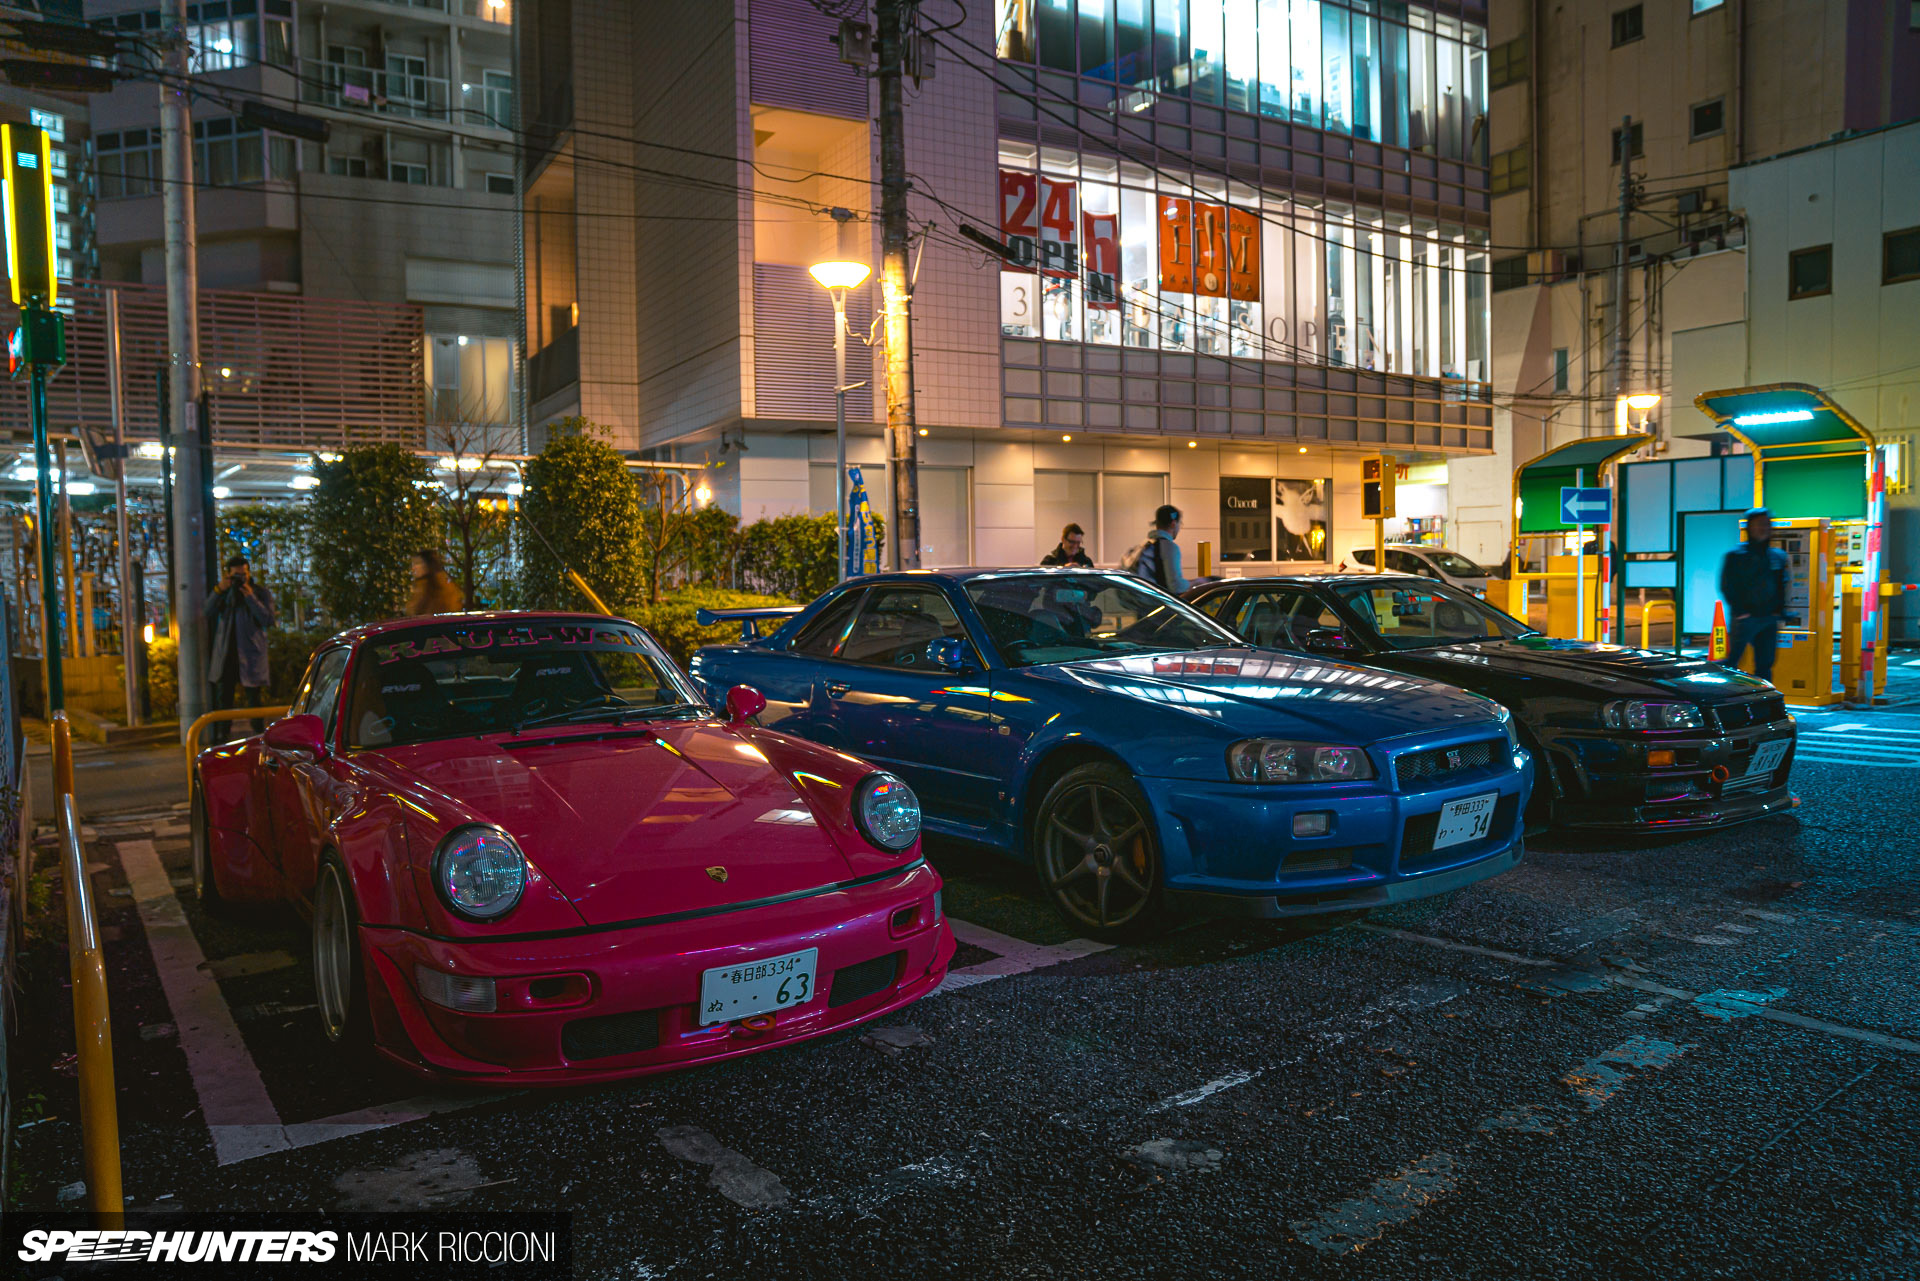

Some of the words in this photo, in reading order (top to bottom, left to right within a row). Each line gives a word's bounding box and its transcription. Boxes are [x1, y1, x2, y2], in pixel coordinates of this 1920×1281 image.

[1227, 496, 1257, 509] Chacott
[536, 666, 572, 677] RWB
[381, 683, 421, 694] RWB
[1469, 812, 1490, 838] 34
[707, 999, 724, 1013] ぬ
[775, 972, 810, 1005] 63
